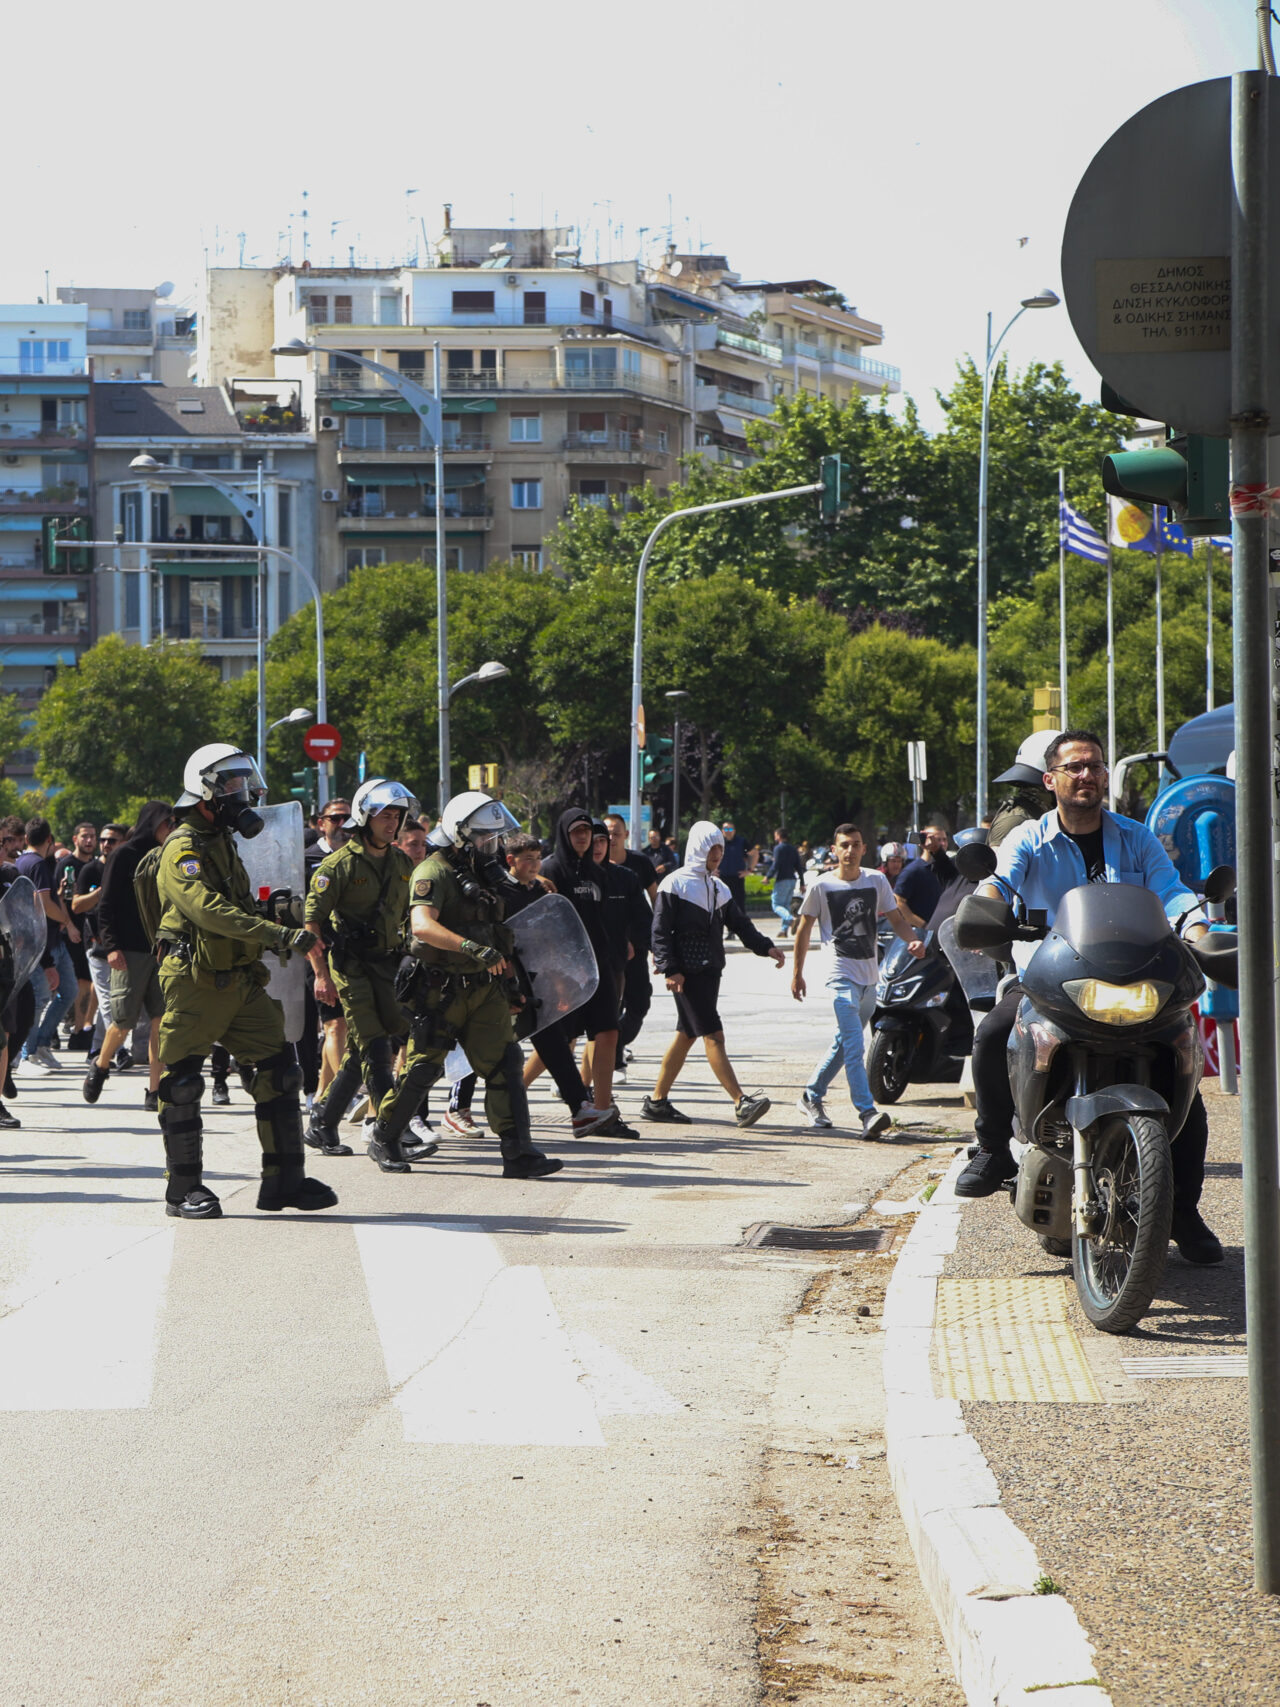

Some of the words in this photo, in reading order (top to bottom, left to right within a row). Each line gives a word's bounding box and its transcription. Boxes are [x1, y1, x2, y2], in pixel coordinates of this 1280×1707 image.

[1157, 266, 1204, 278] ΔΗΜΟΣ
[1130, 280, 1231, 293] ΘΕΣΣΑΛΟΝΙΚΗΣ
[1113, 297, 1152, 309] Δ/ΝΣΗ
[1113, 313, 1122, 324] &
[1126, 311, 1175, 323] ΟΔΙΚΗΣ
[1142, 327, 1170, 338] ΤΗΛ.
[1175, 325, 1221, 337] 911.711
